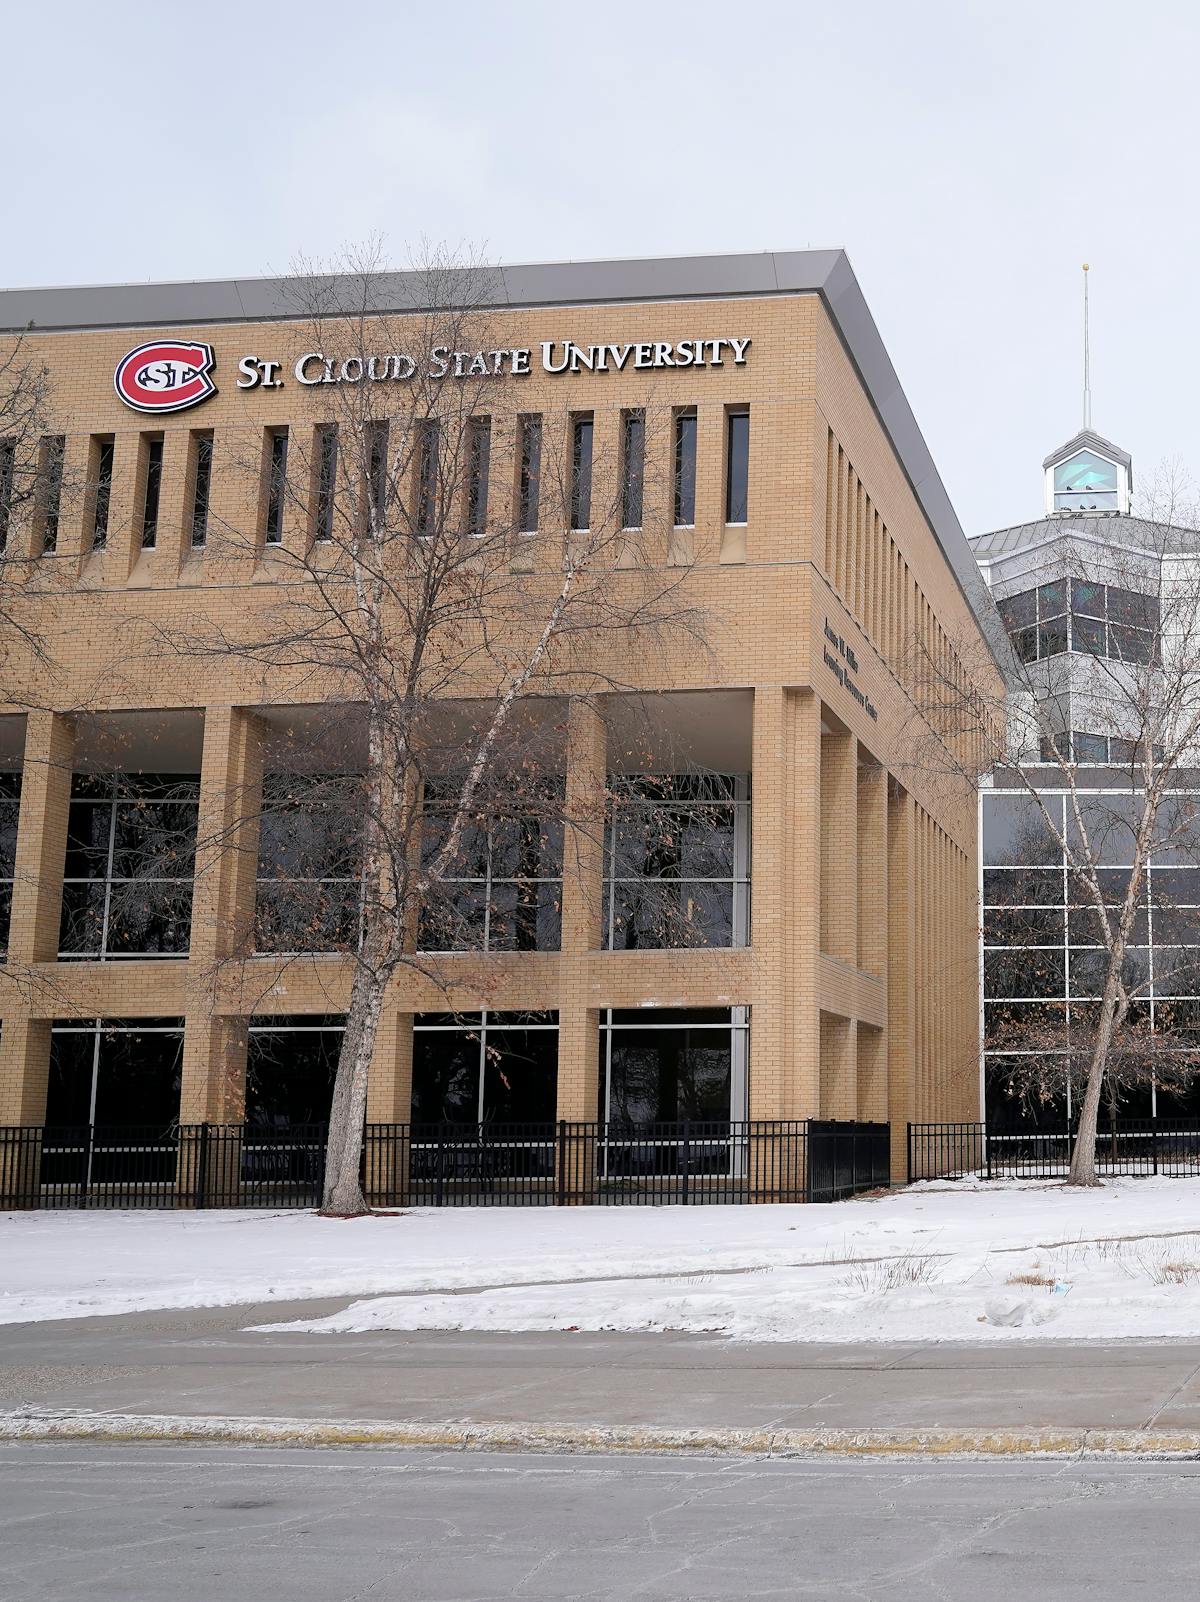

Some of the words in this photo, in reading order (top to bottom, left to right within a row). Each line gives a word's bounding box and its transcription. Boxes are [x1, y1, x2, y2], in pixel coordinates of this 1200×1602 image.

[294, 352, 416, 386] CLOUD
[427, 346, 530, 378] STATE
[539, 337, 751, 373] UNIVERSITY
